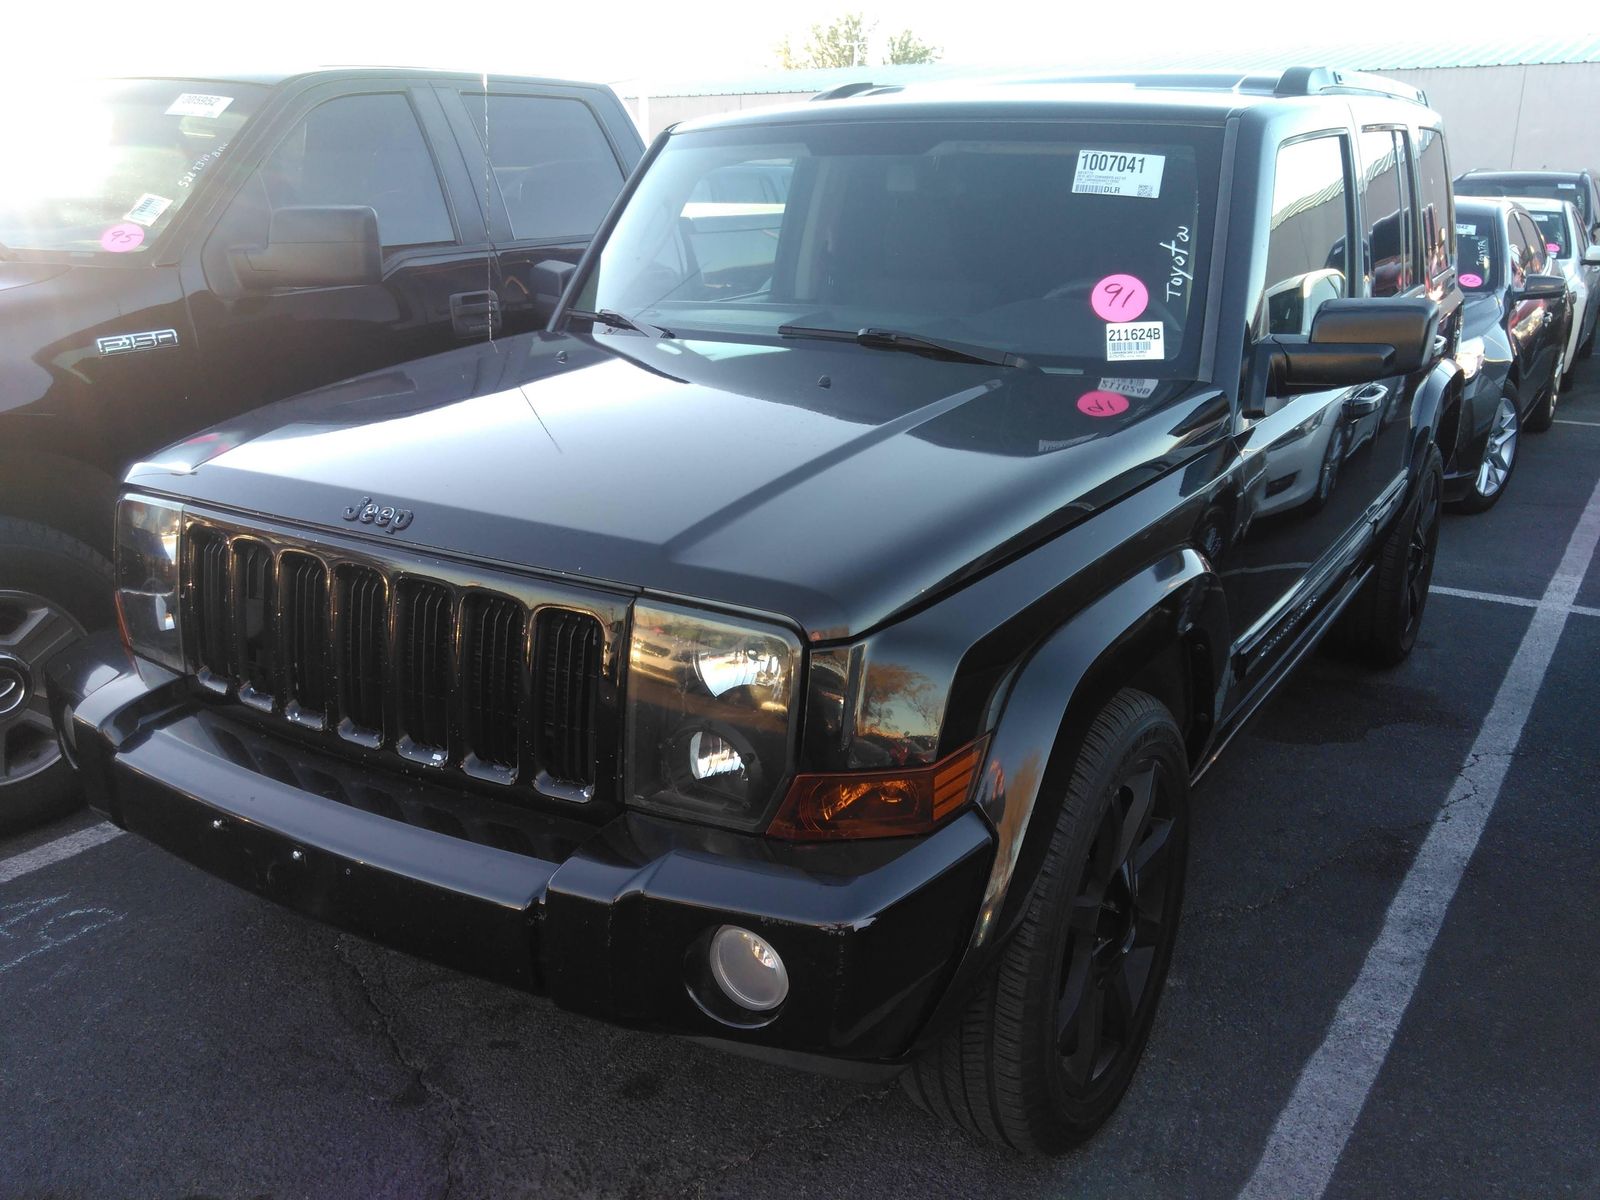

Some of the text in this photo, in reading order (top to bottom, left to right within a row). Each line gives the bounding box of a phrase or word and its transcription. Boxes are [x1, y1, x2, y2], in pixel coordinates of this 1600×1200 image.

[1082, 153, 1145, 174] 1007041
[1103, 186, 1120, 194] DLR
[112, 230, 142, 244] 95
[1159, 225, 1193, 303] Toyota
[1104, 283, 1135, 308] 91
[1109, 328, 1161, 342] 211624B
[343, 496, 414, 534] Jeep
